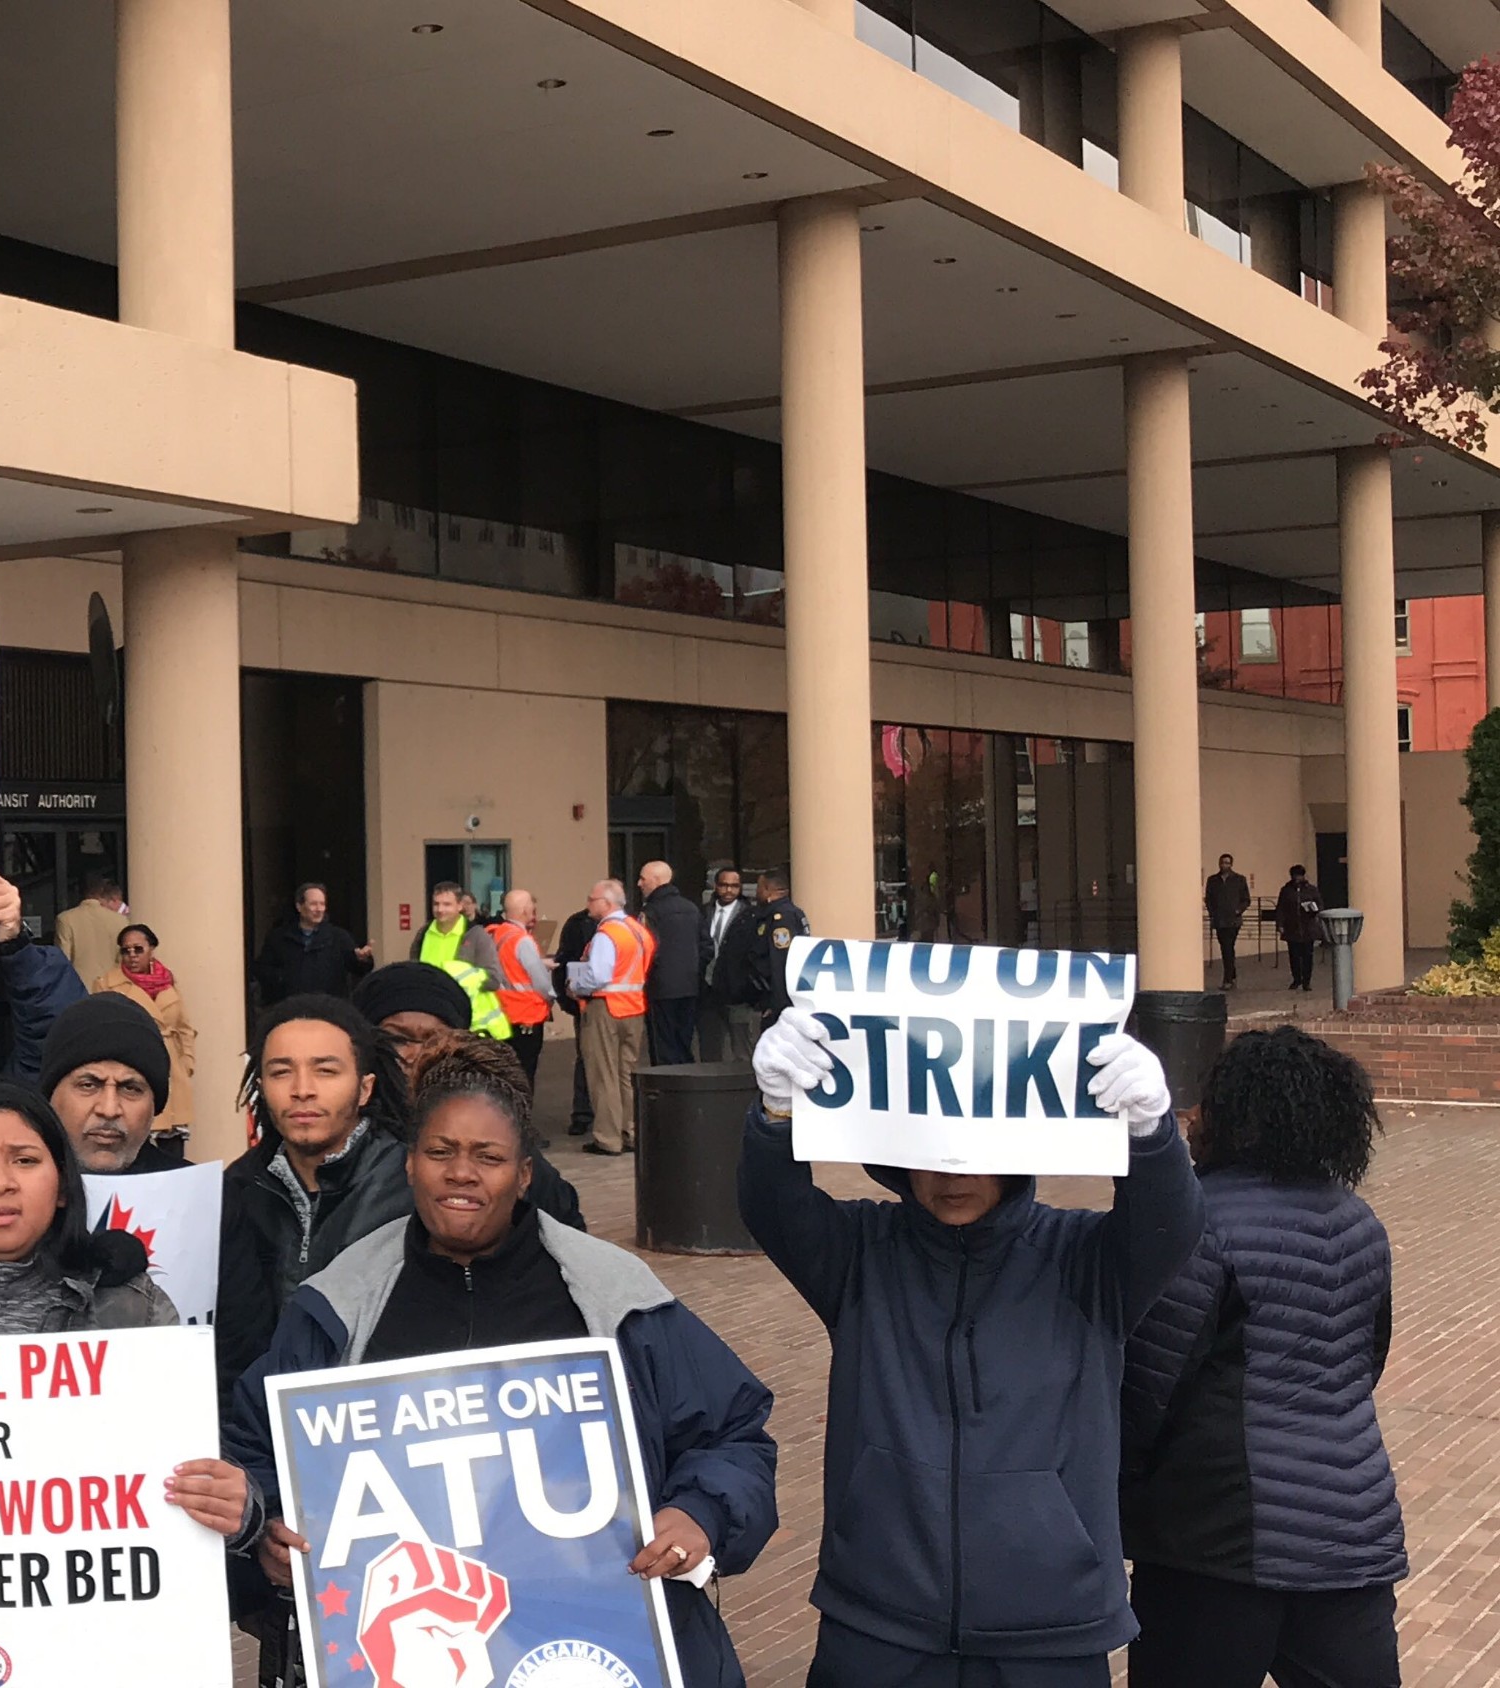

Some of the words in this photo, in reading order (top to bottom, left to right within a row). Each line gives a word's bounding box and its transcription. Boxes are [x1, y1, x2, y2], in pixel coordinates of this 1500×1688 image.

[38, 794, 97, 808] AUTHORITY
[796, 938, 972, 996] ATU
[996, 946, 1125, 1000] ON
[805, 1012, 1119, 1119] STRIKE
[20, 1340, 109, 1399] PAY
[296, 1400, 381, 1446] WE
[392, 1384, 489, 1436] ARE
[497, 1372, 604, 1419] ONE
[319, 1420, 619, 1569] ATU
[65, 1546, 161, 1604] BED
[510, 1641, 635, 1688] MALGAMATED
